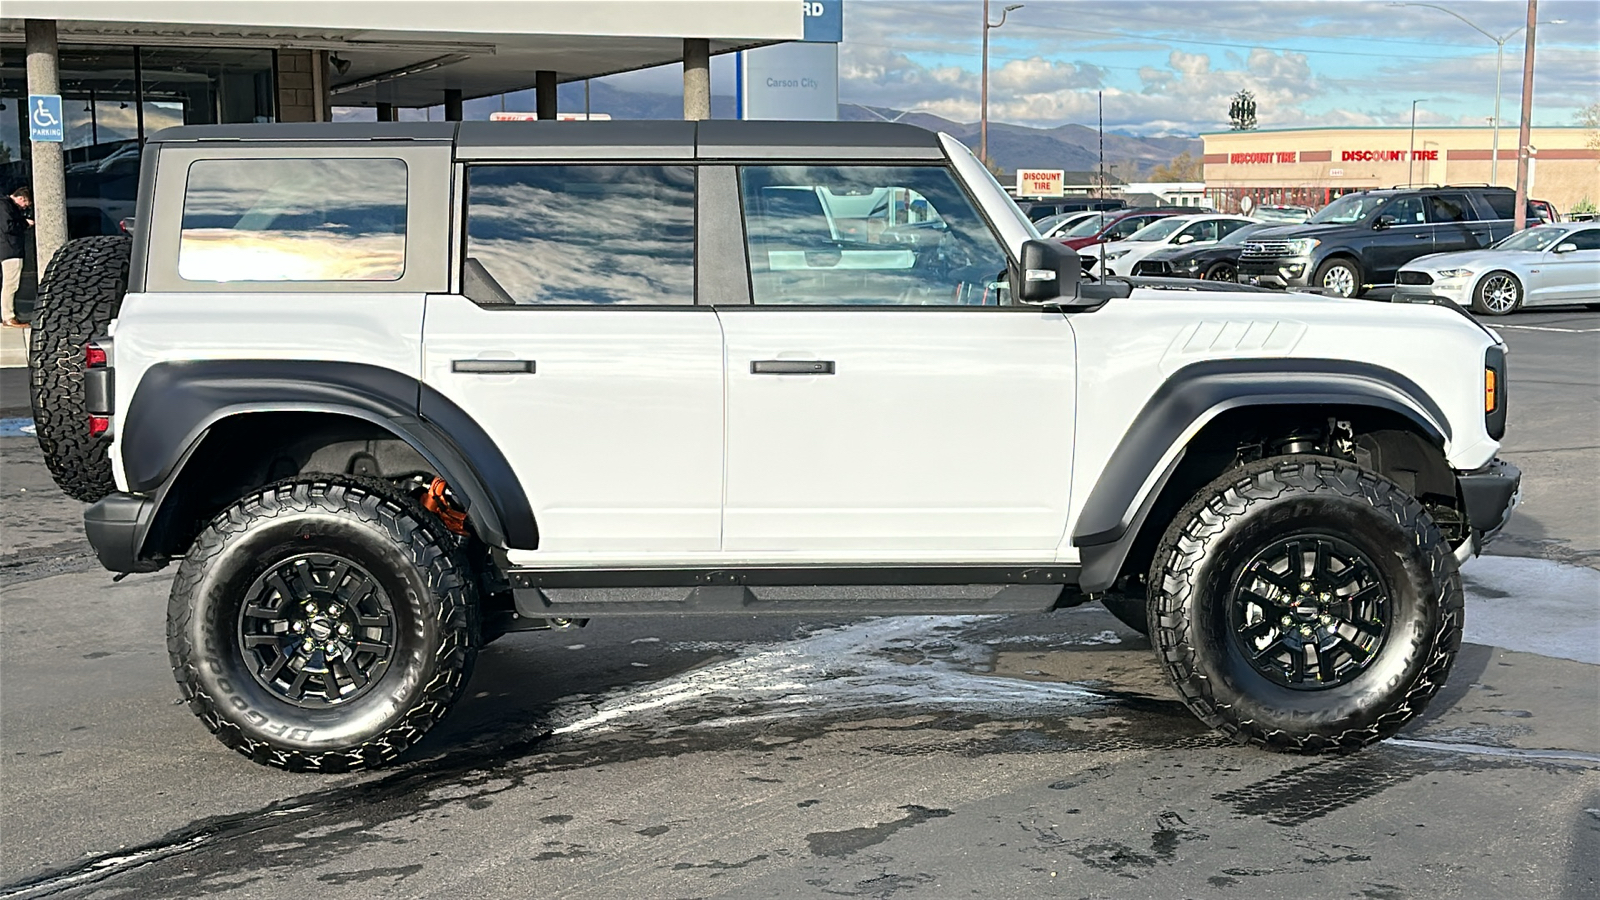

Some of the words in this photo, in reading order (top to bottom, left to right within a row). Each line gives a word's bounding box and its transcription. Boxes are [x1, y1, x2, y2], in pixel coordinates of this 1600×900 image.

[766, 77, 799, 88] Carson
[801, 78, 819, 90] City
[32, 128, 61, 136] PARKING
[1230, 152, 1274, 164] DISCOUNT
[1276, 151, 1296, 163] TIRE
[1342, 150, 1407, 161] DISCOUNT
[1410, 150, 1438, 161] TIRE
[1023, 172, 1061, 181] DISCOUNT
[1033, 182, 1051, 190] TIRE
